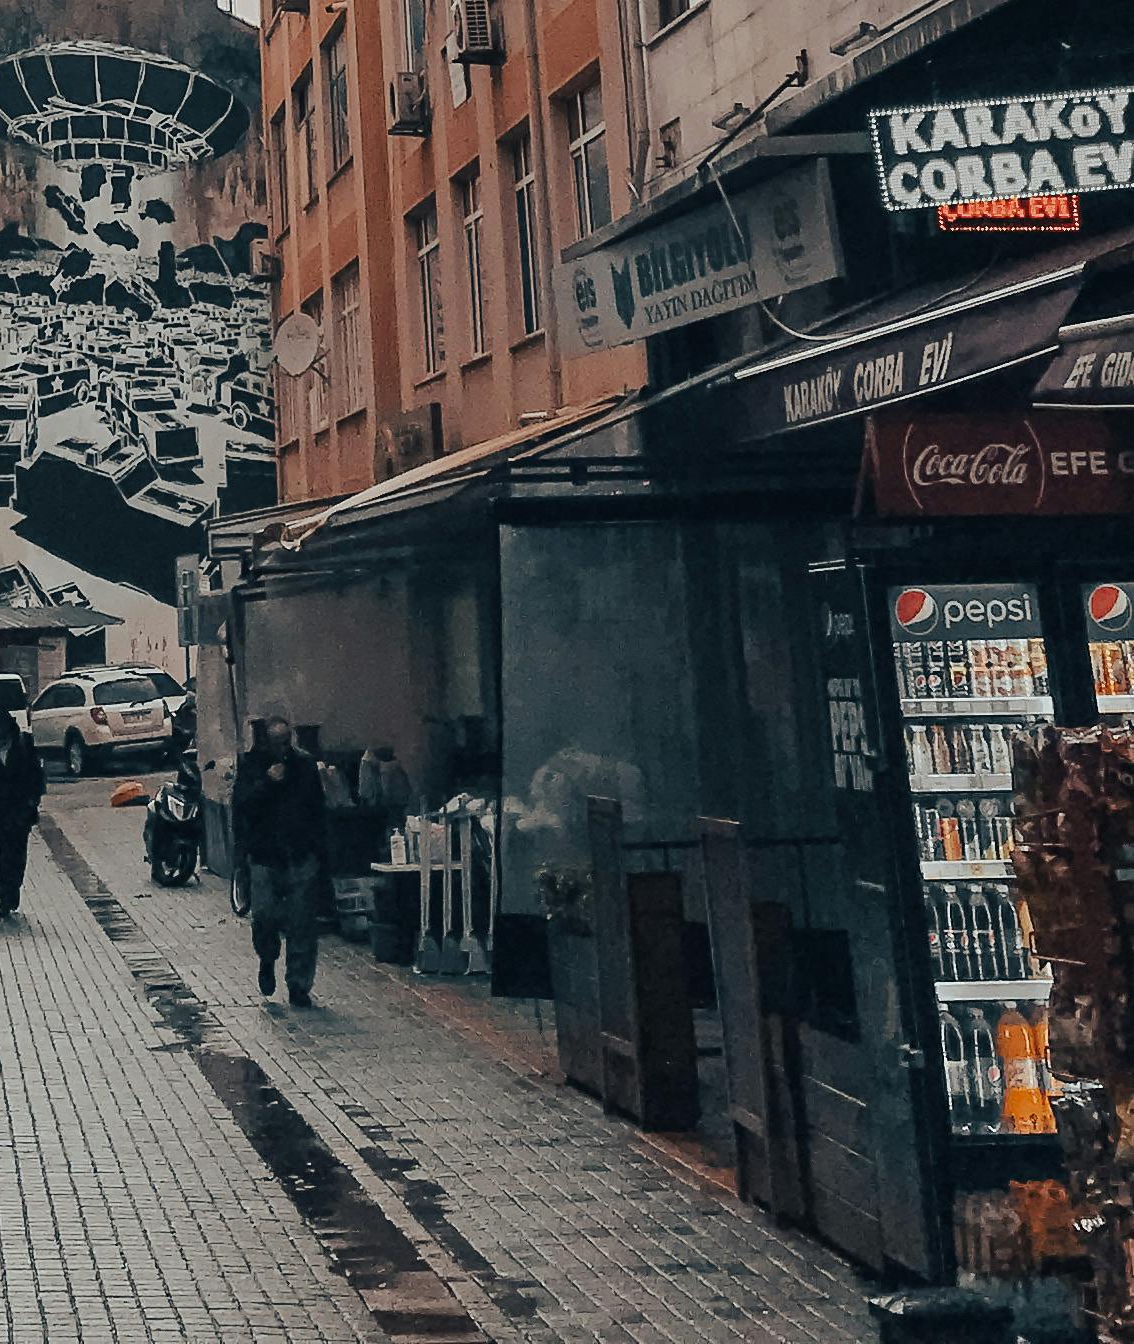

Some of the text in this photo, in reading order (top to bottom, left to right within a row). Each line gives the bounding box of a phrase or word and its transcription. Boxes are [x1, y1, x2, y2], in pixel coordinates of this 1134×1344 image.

[1099, 352, 1134, 389] GID
[913, 443, 1032, 486] Coca-Cola
[1050, 450, 1109, 476] EFE
[943, 593, 1032, 629] pepsi
